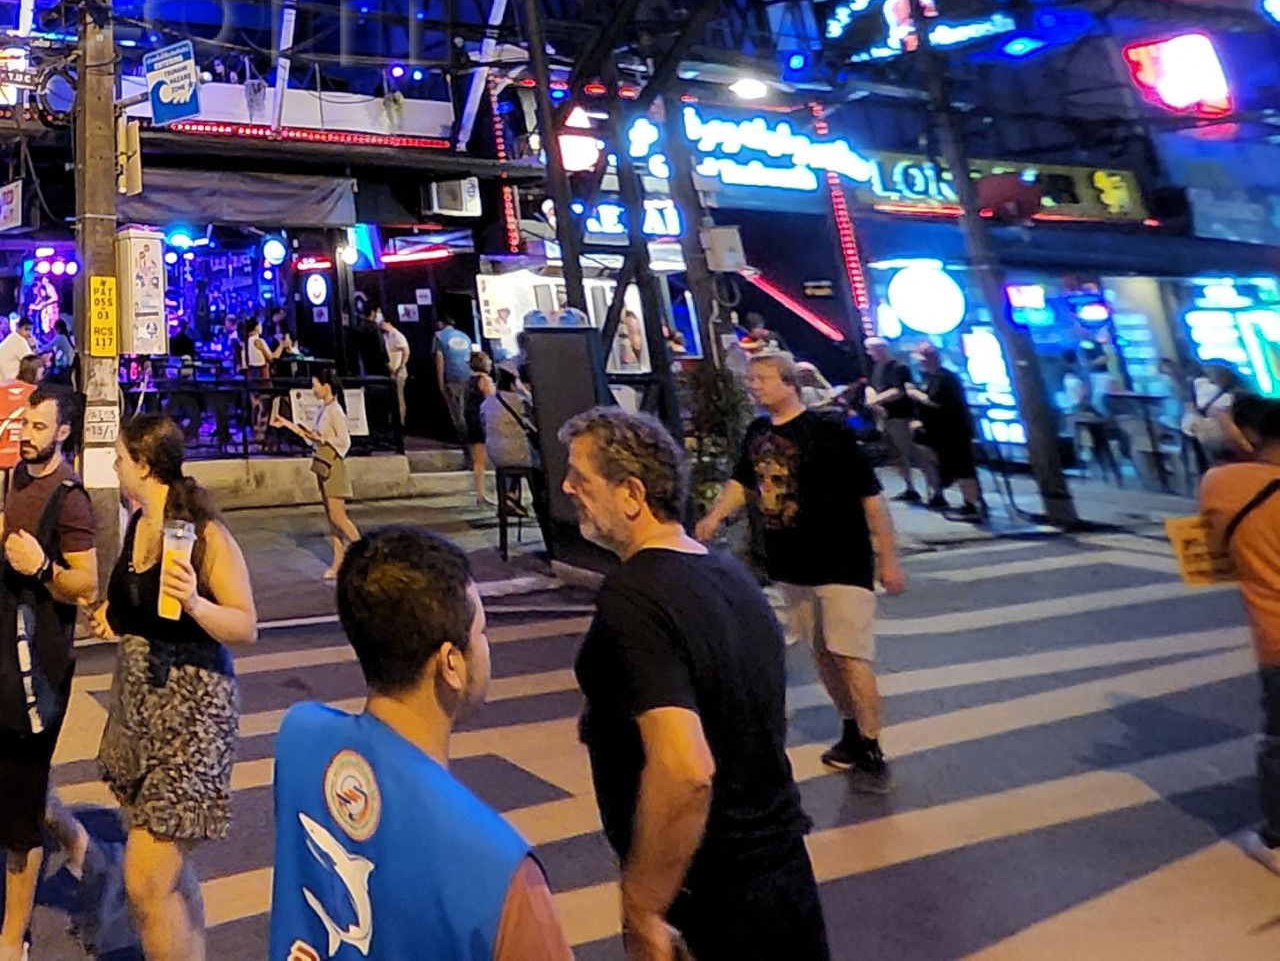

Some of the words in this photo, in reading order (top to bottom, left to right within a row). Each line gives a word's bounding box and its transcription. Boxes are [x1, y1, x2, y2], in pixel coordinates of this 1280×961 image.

[164, 65, 188, 76] TSUNAMI
[169, 73, 191, 85] HAZARD
[93, 287, 114, 297] PAT
[96, 311, 110, 320] 03
[93, 327, 114, 336] RCS
[94, 337, 114, 347] 117
